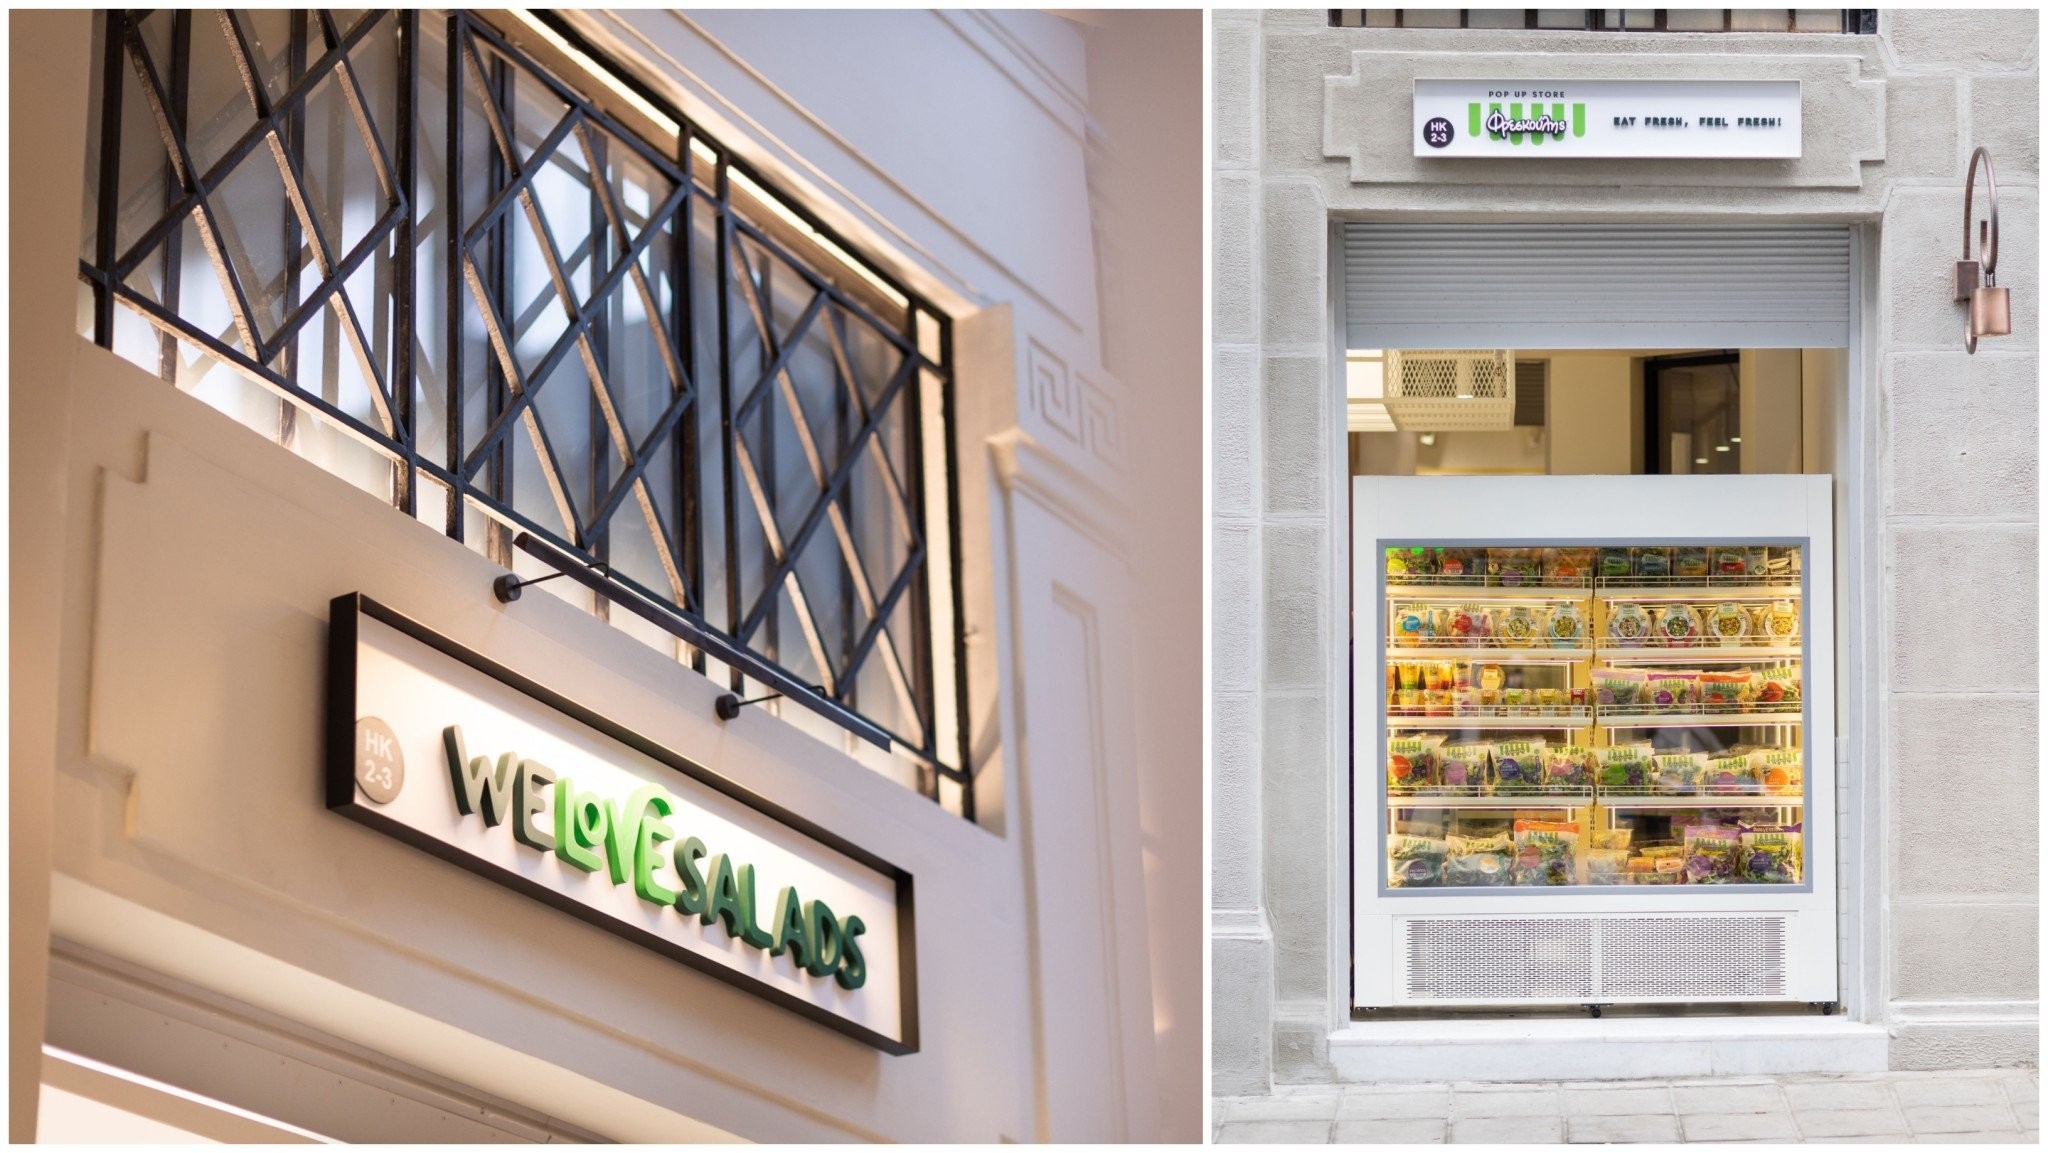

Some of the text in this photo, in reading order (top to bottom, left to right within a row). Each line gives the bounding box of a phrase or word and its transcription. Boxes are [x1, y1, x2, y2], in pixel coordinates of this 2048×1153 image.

[1488, 91, 1565, 99] POP UP STORE
[1430, 122, 1447, 132] HK
[1613, 116, 1782, 128] EAT FRESH, FEEL FRESH!
[1430, 133, 1447, 143] 2-3
[365, 728, 393, 762] HK
[365, 759, 392, 790] 2-3
